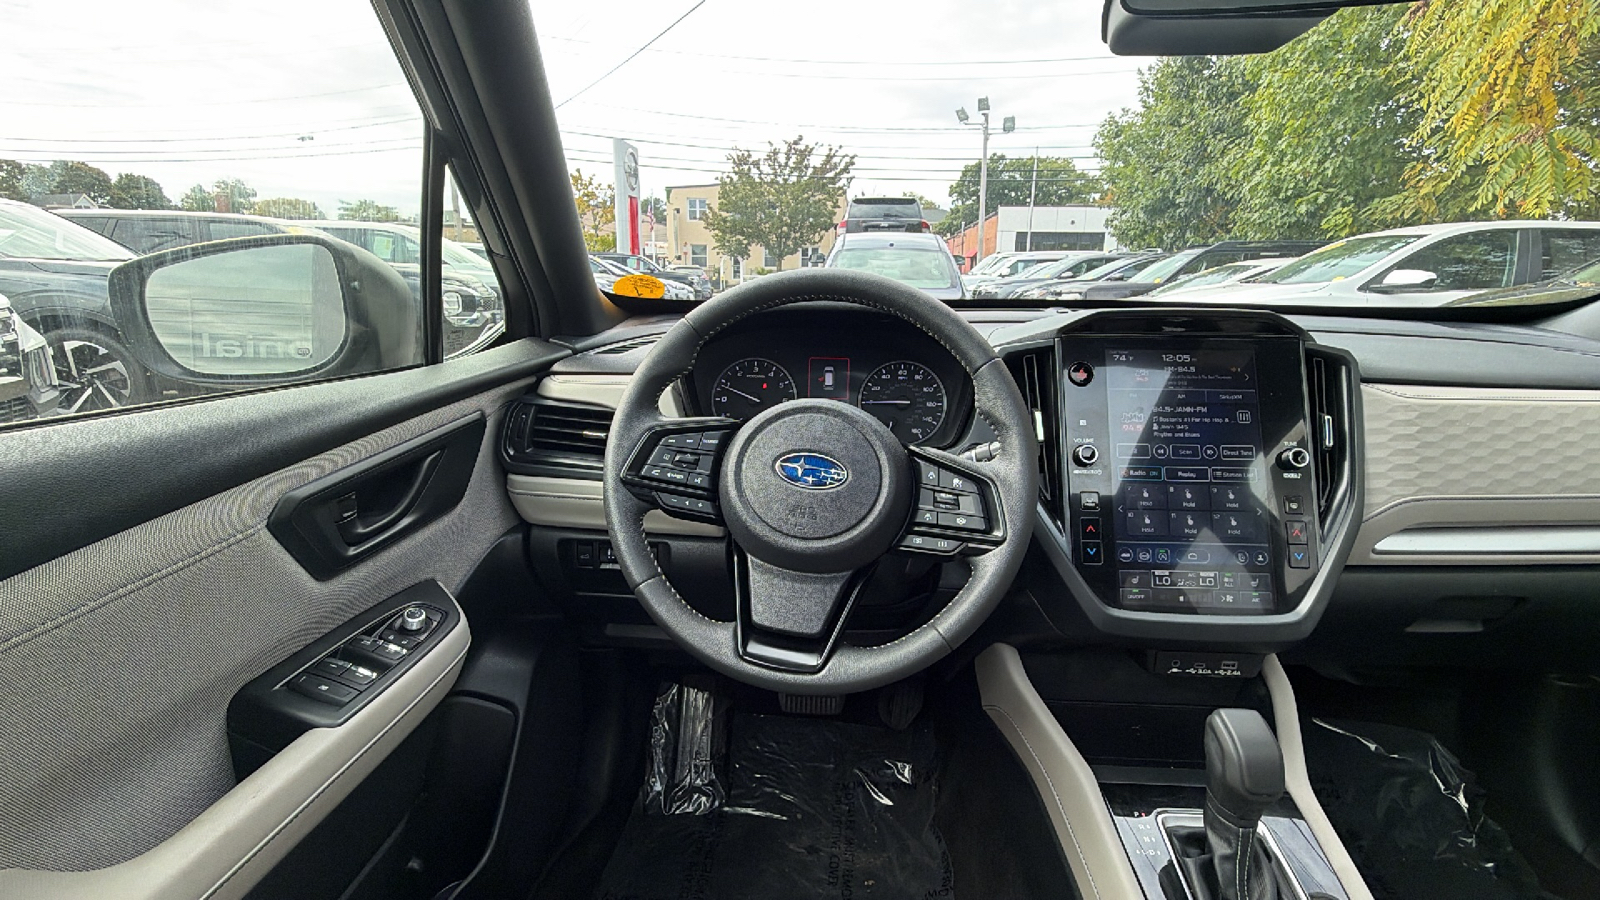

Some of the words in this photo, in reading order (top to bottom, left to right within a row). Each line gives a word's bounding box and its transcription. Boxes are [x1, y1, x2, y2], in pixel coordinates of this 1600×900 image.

[1161, 353, 1191, 362] 12:05
[1155, 576, 1171, 585] LO
[1199, 577, 1215, 586] LO
